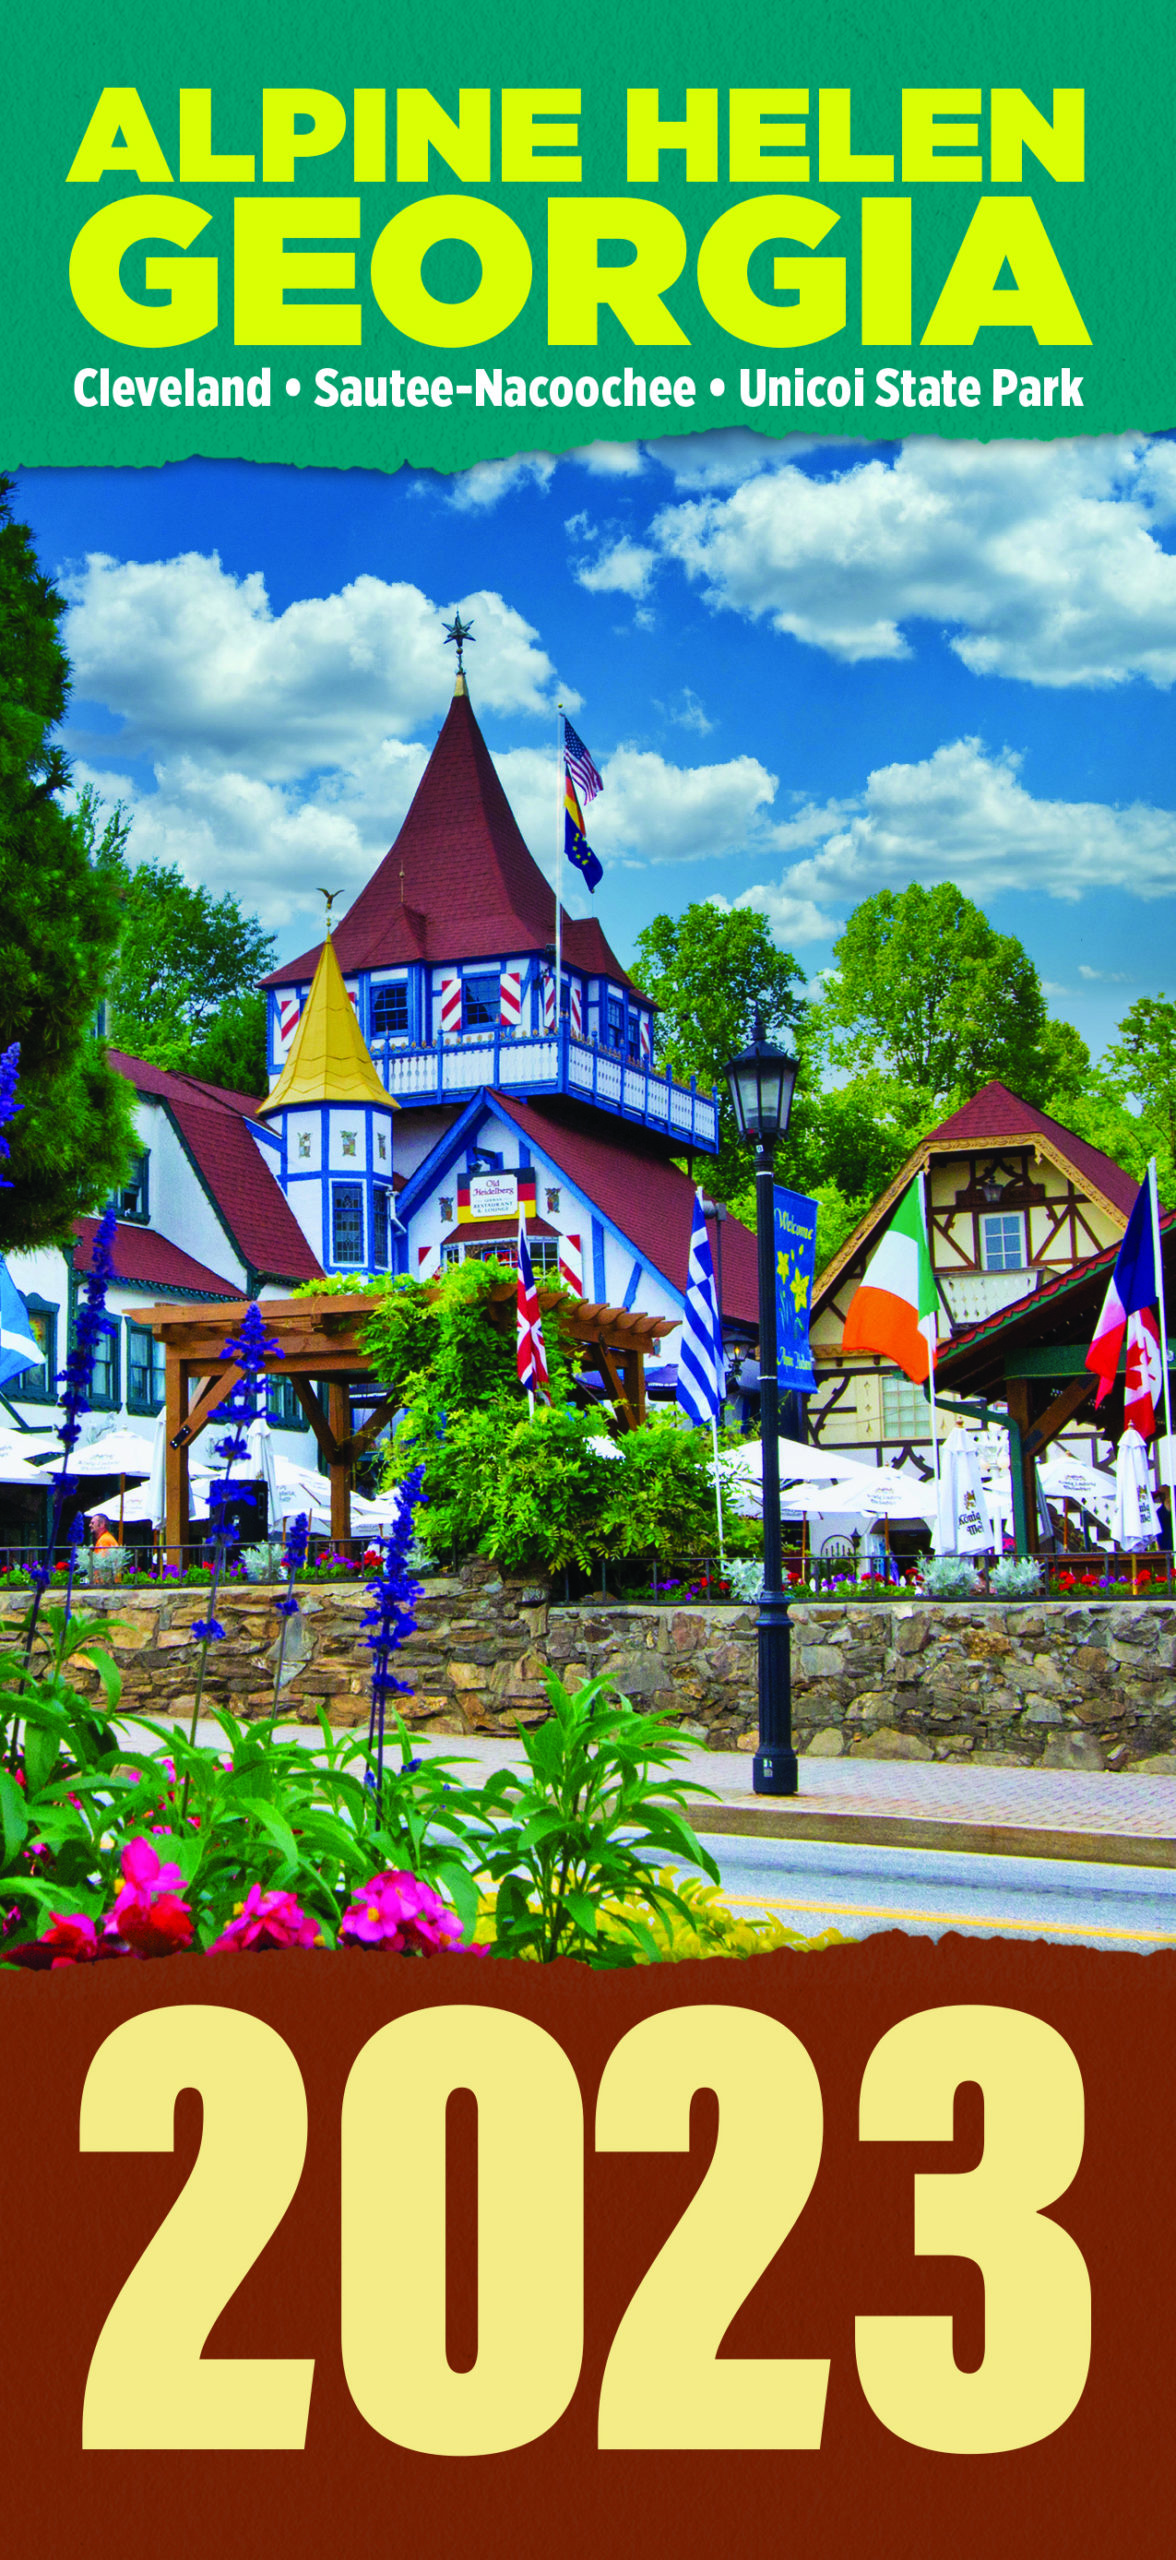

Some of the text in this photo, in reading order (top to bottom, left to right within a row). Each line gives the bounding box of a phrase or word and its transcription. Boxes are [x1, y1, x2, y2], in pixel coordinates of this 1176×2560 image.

[486, 1179, 500, 1188] Old
[473, 1187, 514, 1197] Heidelberg
[473, 1201, 513, 1209] RESTAURANT
[773, 1207, 814, 1240] Welcome
